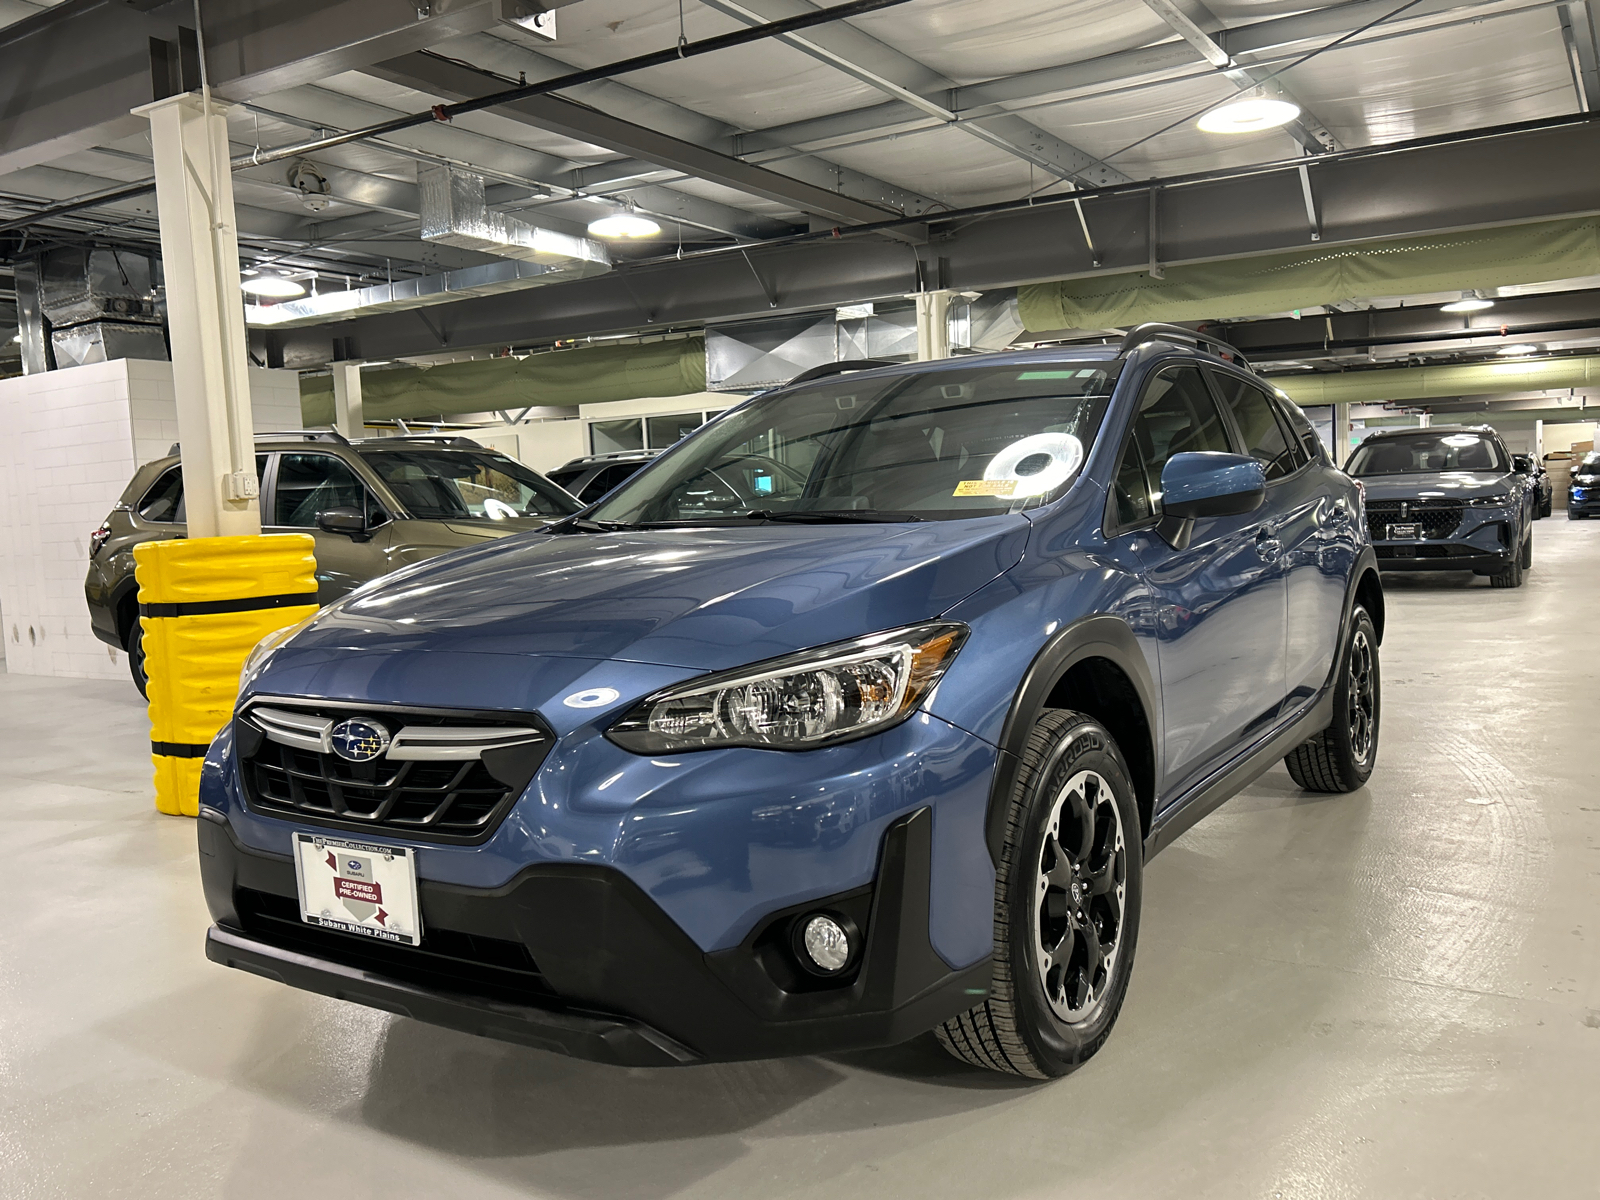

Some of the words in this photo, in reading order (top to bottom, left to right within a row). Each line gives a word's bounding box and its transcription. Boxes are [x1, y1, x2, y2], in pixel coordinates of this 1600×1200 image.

[1048, 731, 1100, 806] ARROYO
[339, 888, 378, 901] PRE-OWNED
[341, 881, 374, 893] CERTIFIED
[318, 917, 346, 929] Subaru
[348, 923, 372, 935] White
[374, 929, 400, 941] Plains
